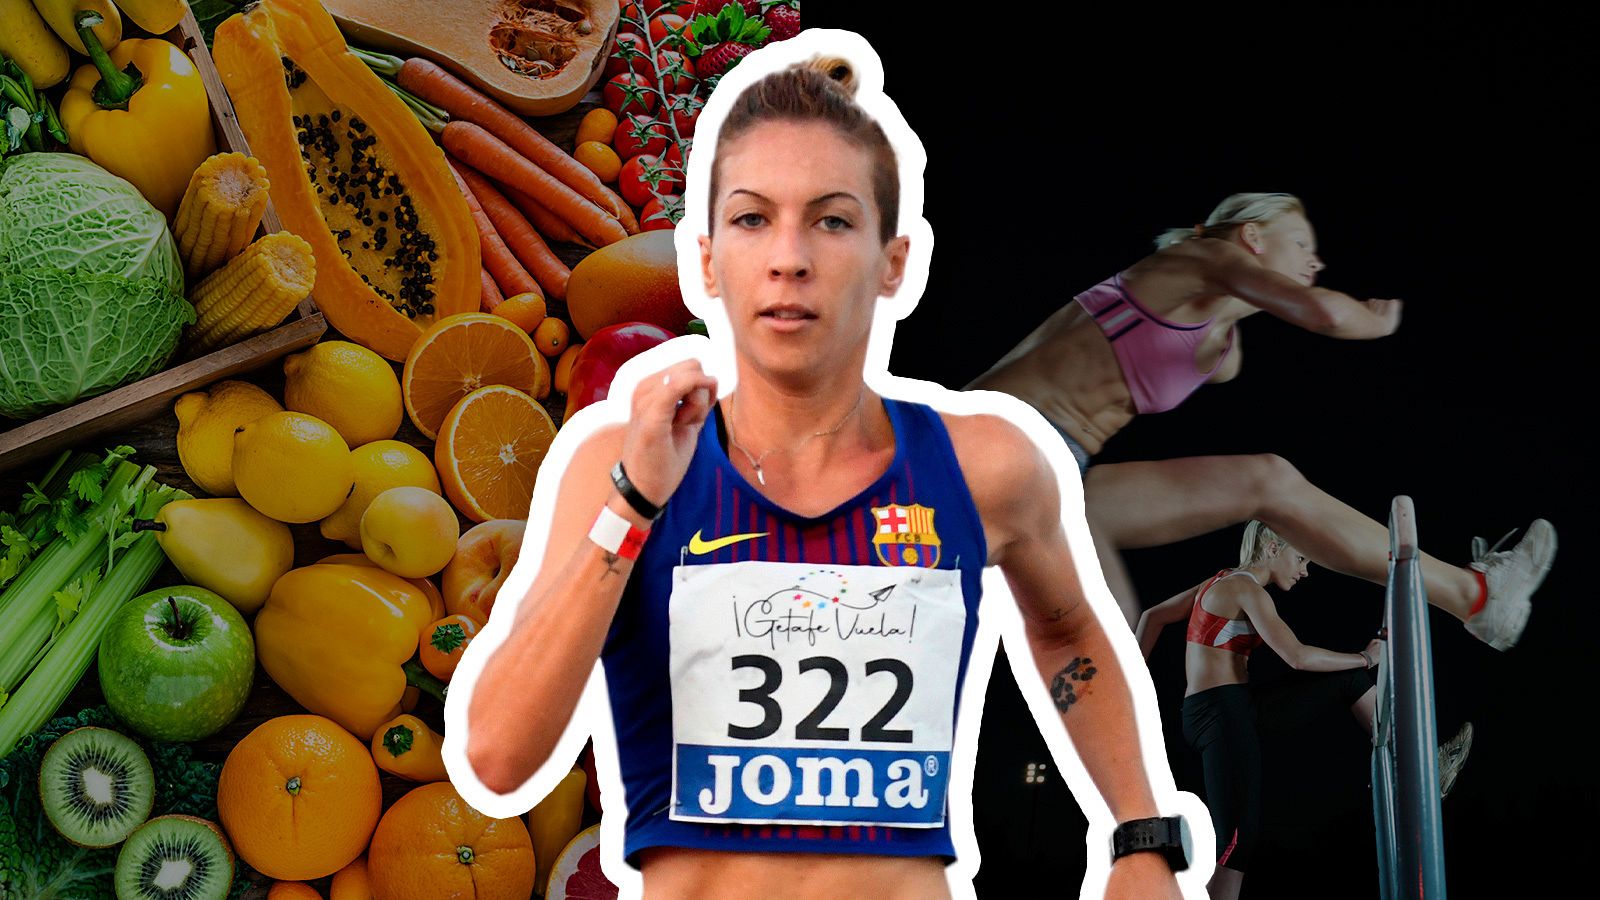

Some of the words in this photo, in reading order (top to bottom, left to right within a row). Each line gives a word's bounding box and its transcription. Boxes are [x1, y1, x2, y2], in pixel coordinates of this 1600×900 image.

[895, 533, 920, 543] FCB
[835, 604, 917, 644] Vuela!
[727, 654, 914, 743] 322
